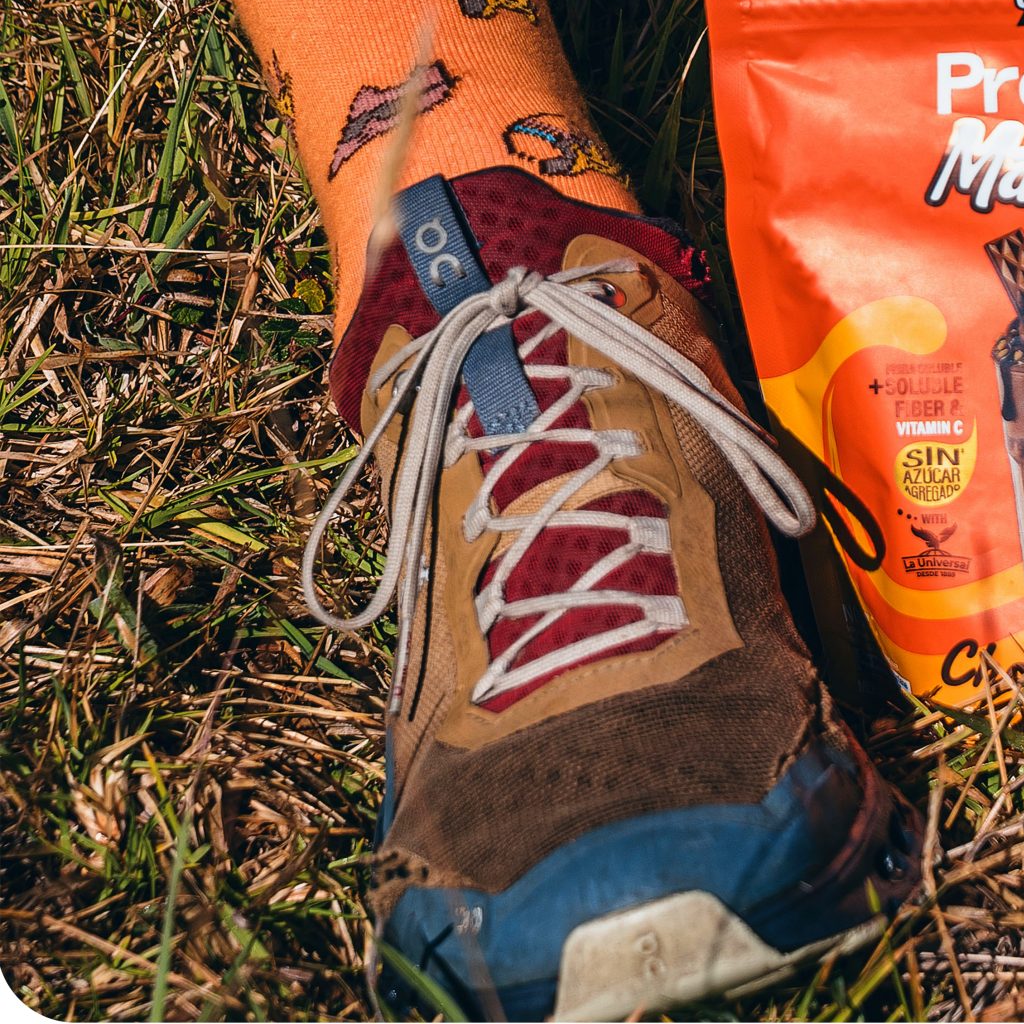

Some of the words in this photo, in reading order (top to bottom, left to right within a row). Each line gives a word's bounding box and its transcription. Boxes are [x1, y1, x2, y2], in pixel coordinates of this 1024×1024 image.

[896, 421, 951, 437] VITAMIN
[953, 420, 964, 436] C
[903, 466, 961, 485] AZÚCAR
[904, 483, 961, 502] AGREGADO
[921, 513, 948, 525] WITH
[903, 559, 916, 570] La
[917, 558, 970, 570] Universal
